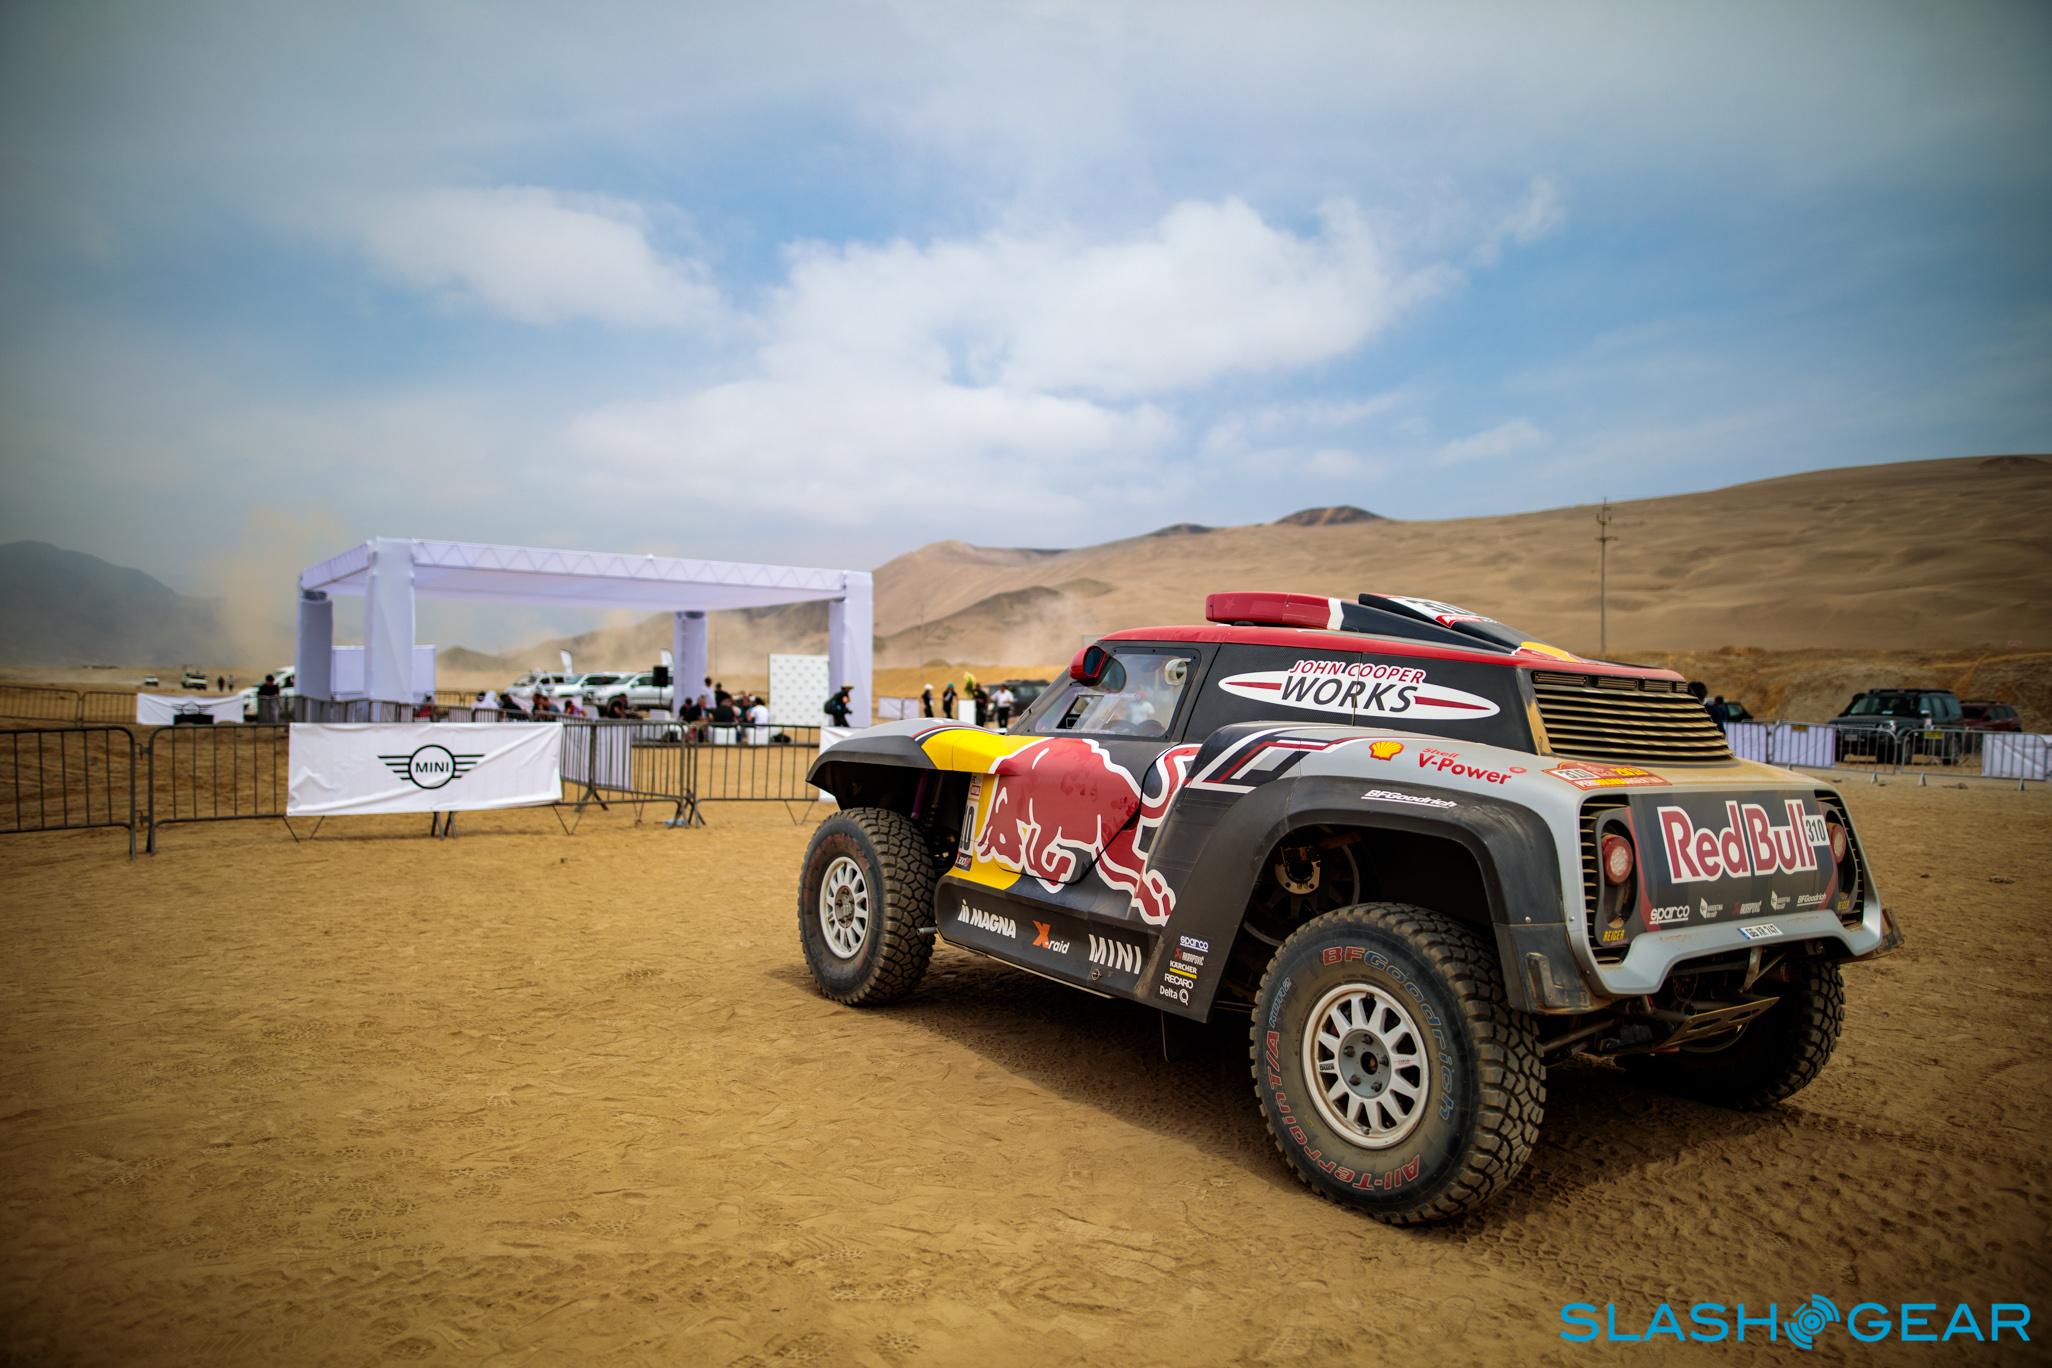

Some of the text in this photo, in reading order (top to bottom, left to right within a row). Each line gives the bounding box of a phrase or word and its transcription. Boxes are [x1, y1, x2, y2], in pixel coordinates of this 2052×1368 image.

[1290, 661, 1424, 684] JOHN COOPER
[1281, 675, 1418, 713] WORKS
[1423, 747, 1461, 758] Shell
[415, 761, 450, 773] MINI
[1419, 753, 1512, 785] V-Power
[1362, 789, 1457, 809] BFGoodrich
[1805, 818, 1826, 842] 310
[970, 908, 1017, 939] MAGNA
[1650, 904, 1690, 923] sparco
[1088, 933, 1142, 975] MINI
[1180, 935, 1209, 951] sparco
[1160, 984, 1178, 1000] Delta
[1164, 972, 1194, 989] RECARO
[1322, 946, 1456, 1121] BFGoodrich
[1265, 1030, 1284, 1090] T/A
[1274, 1091, 1421, 1191] All-Terrain
